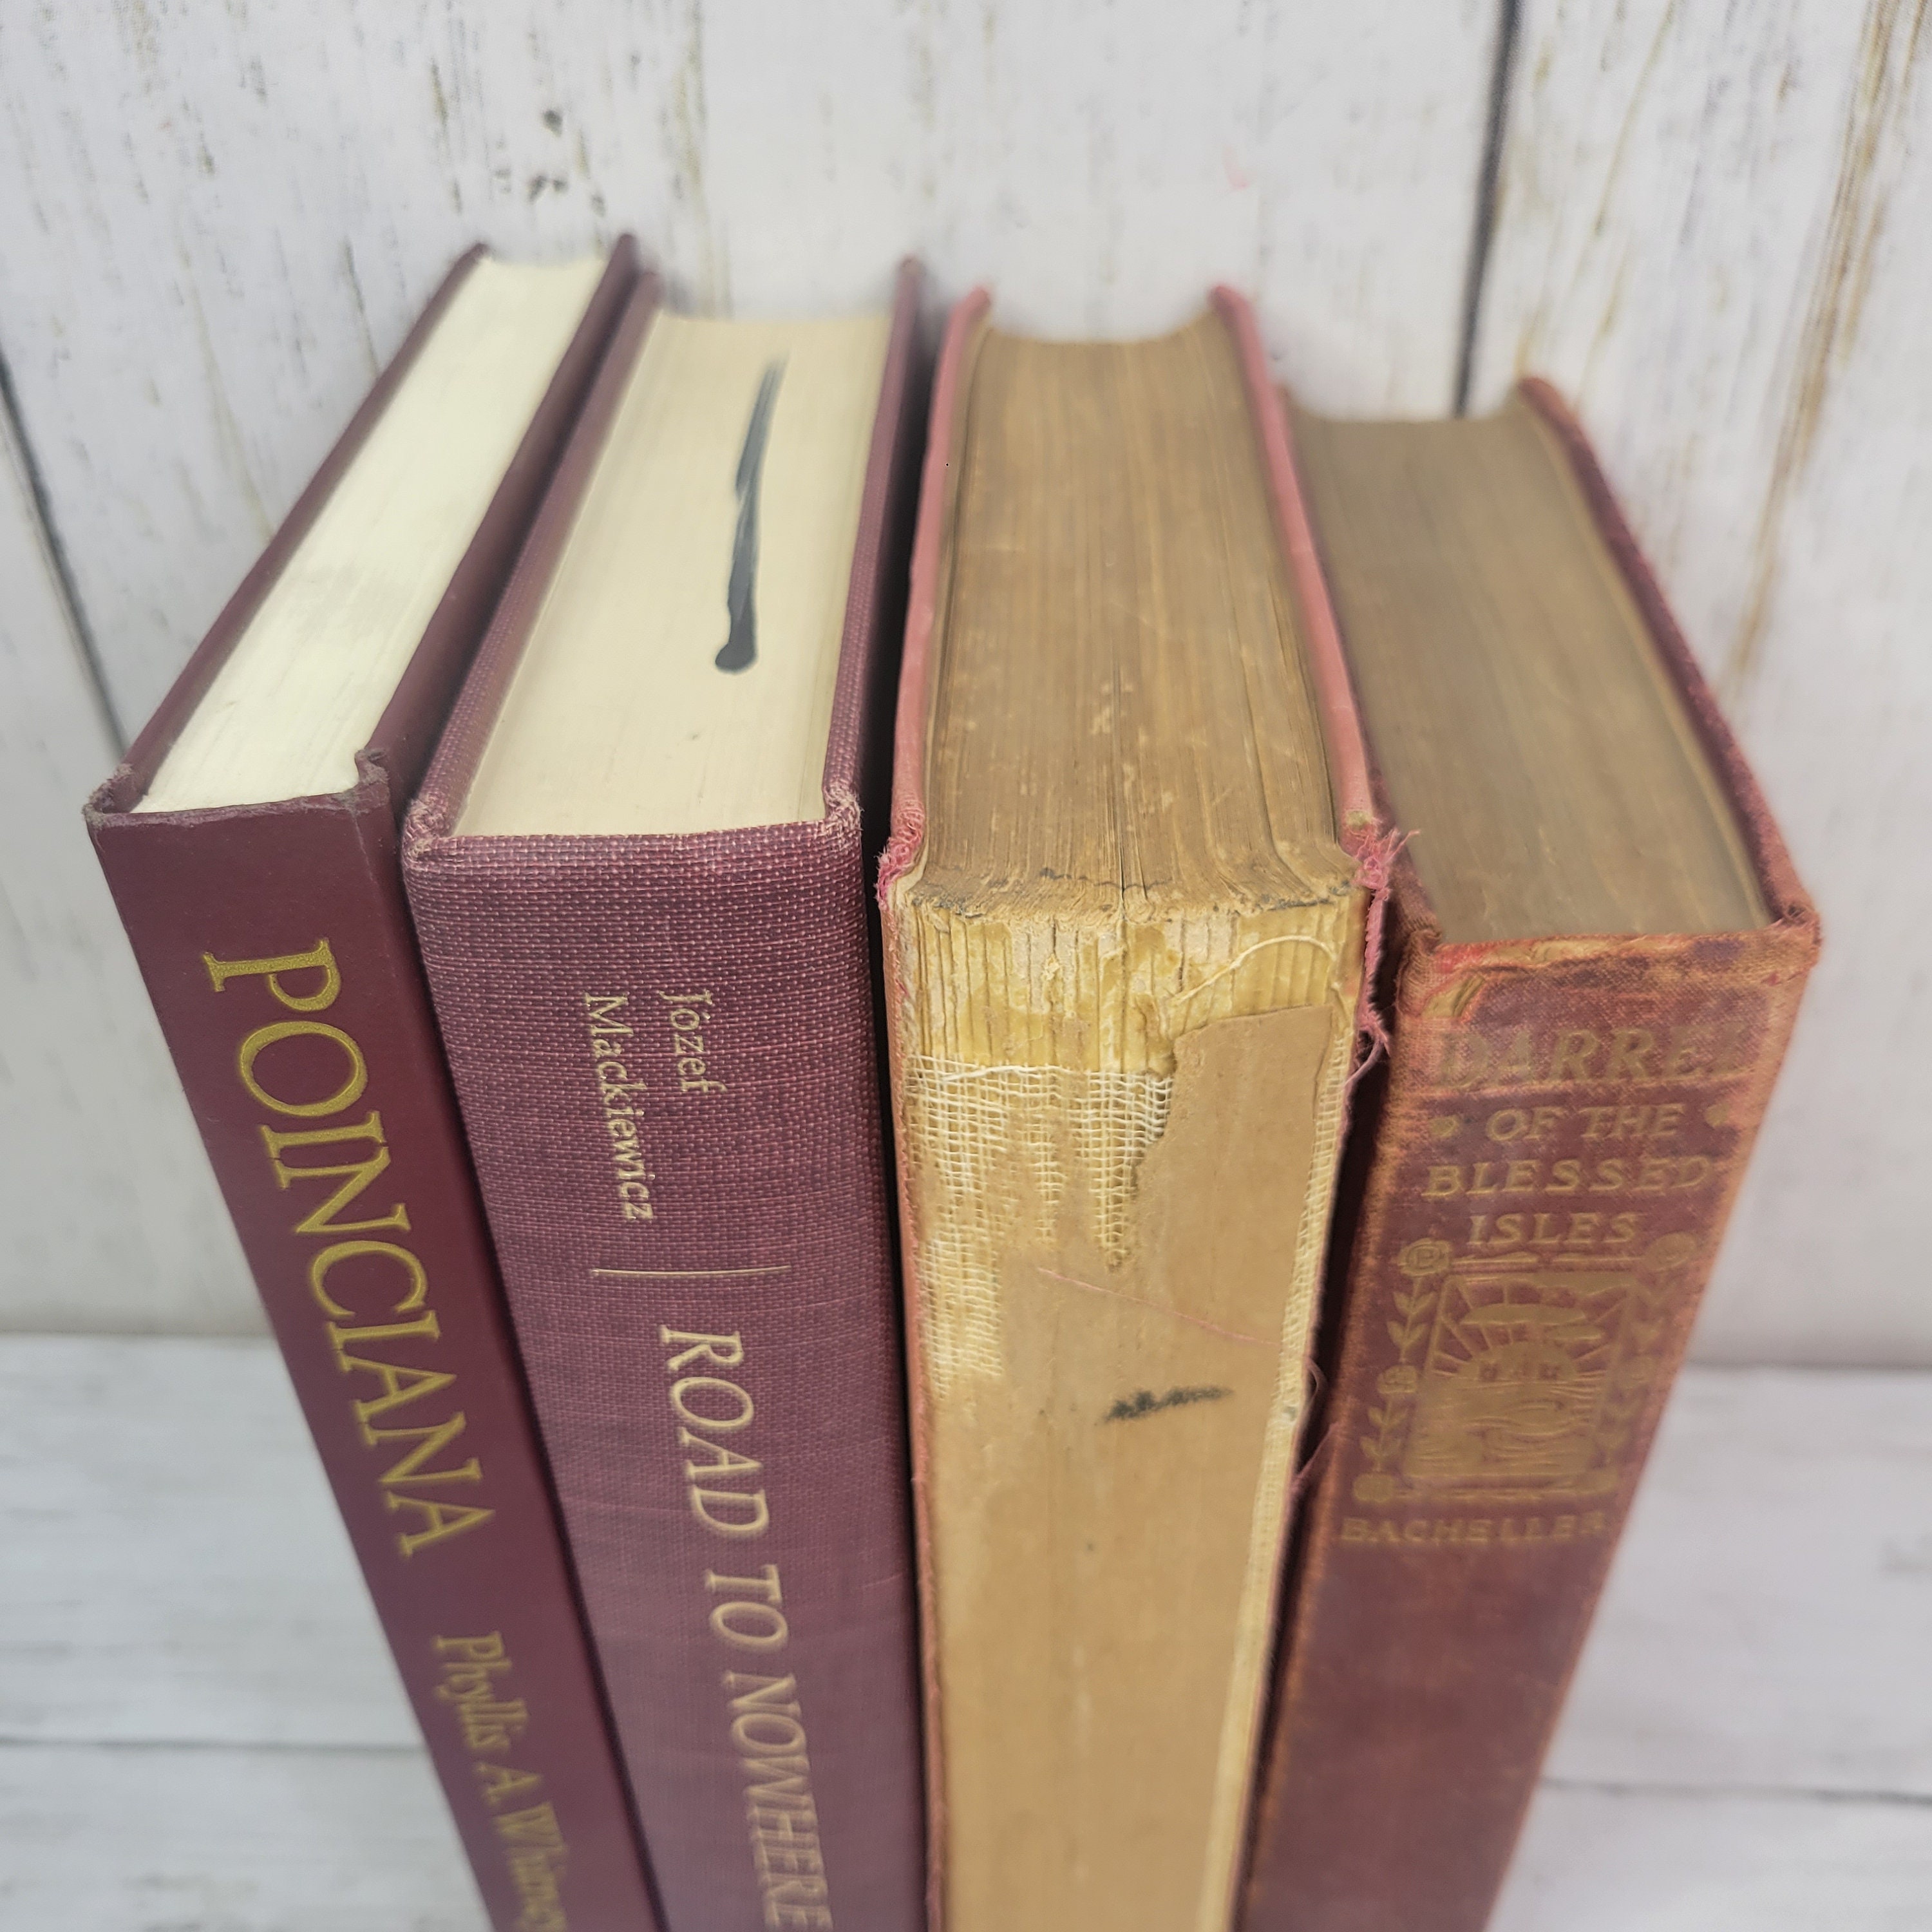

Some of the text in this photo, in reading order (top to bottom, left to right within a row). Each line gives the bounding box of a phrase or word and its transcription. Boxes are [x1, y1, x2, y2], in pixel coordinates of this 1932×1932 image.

[584, 992, 656, 1220] Mackiewicz
[1486, 1103, 1685, 1141] OF THE
[1421, 1155, 1713, 1199] BLESSED
[202, 936, 495, 1558] POINCIANA
[1468, 1213, 1645, 1246] ISLES
[659, 1325, 833, 1932] ROAD TO NOWHERE
[432, 1631, 529, 1752] Phyllis
[473, 1761, 542, 1804] A
